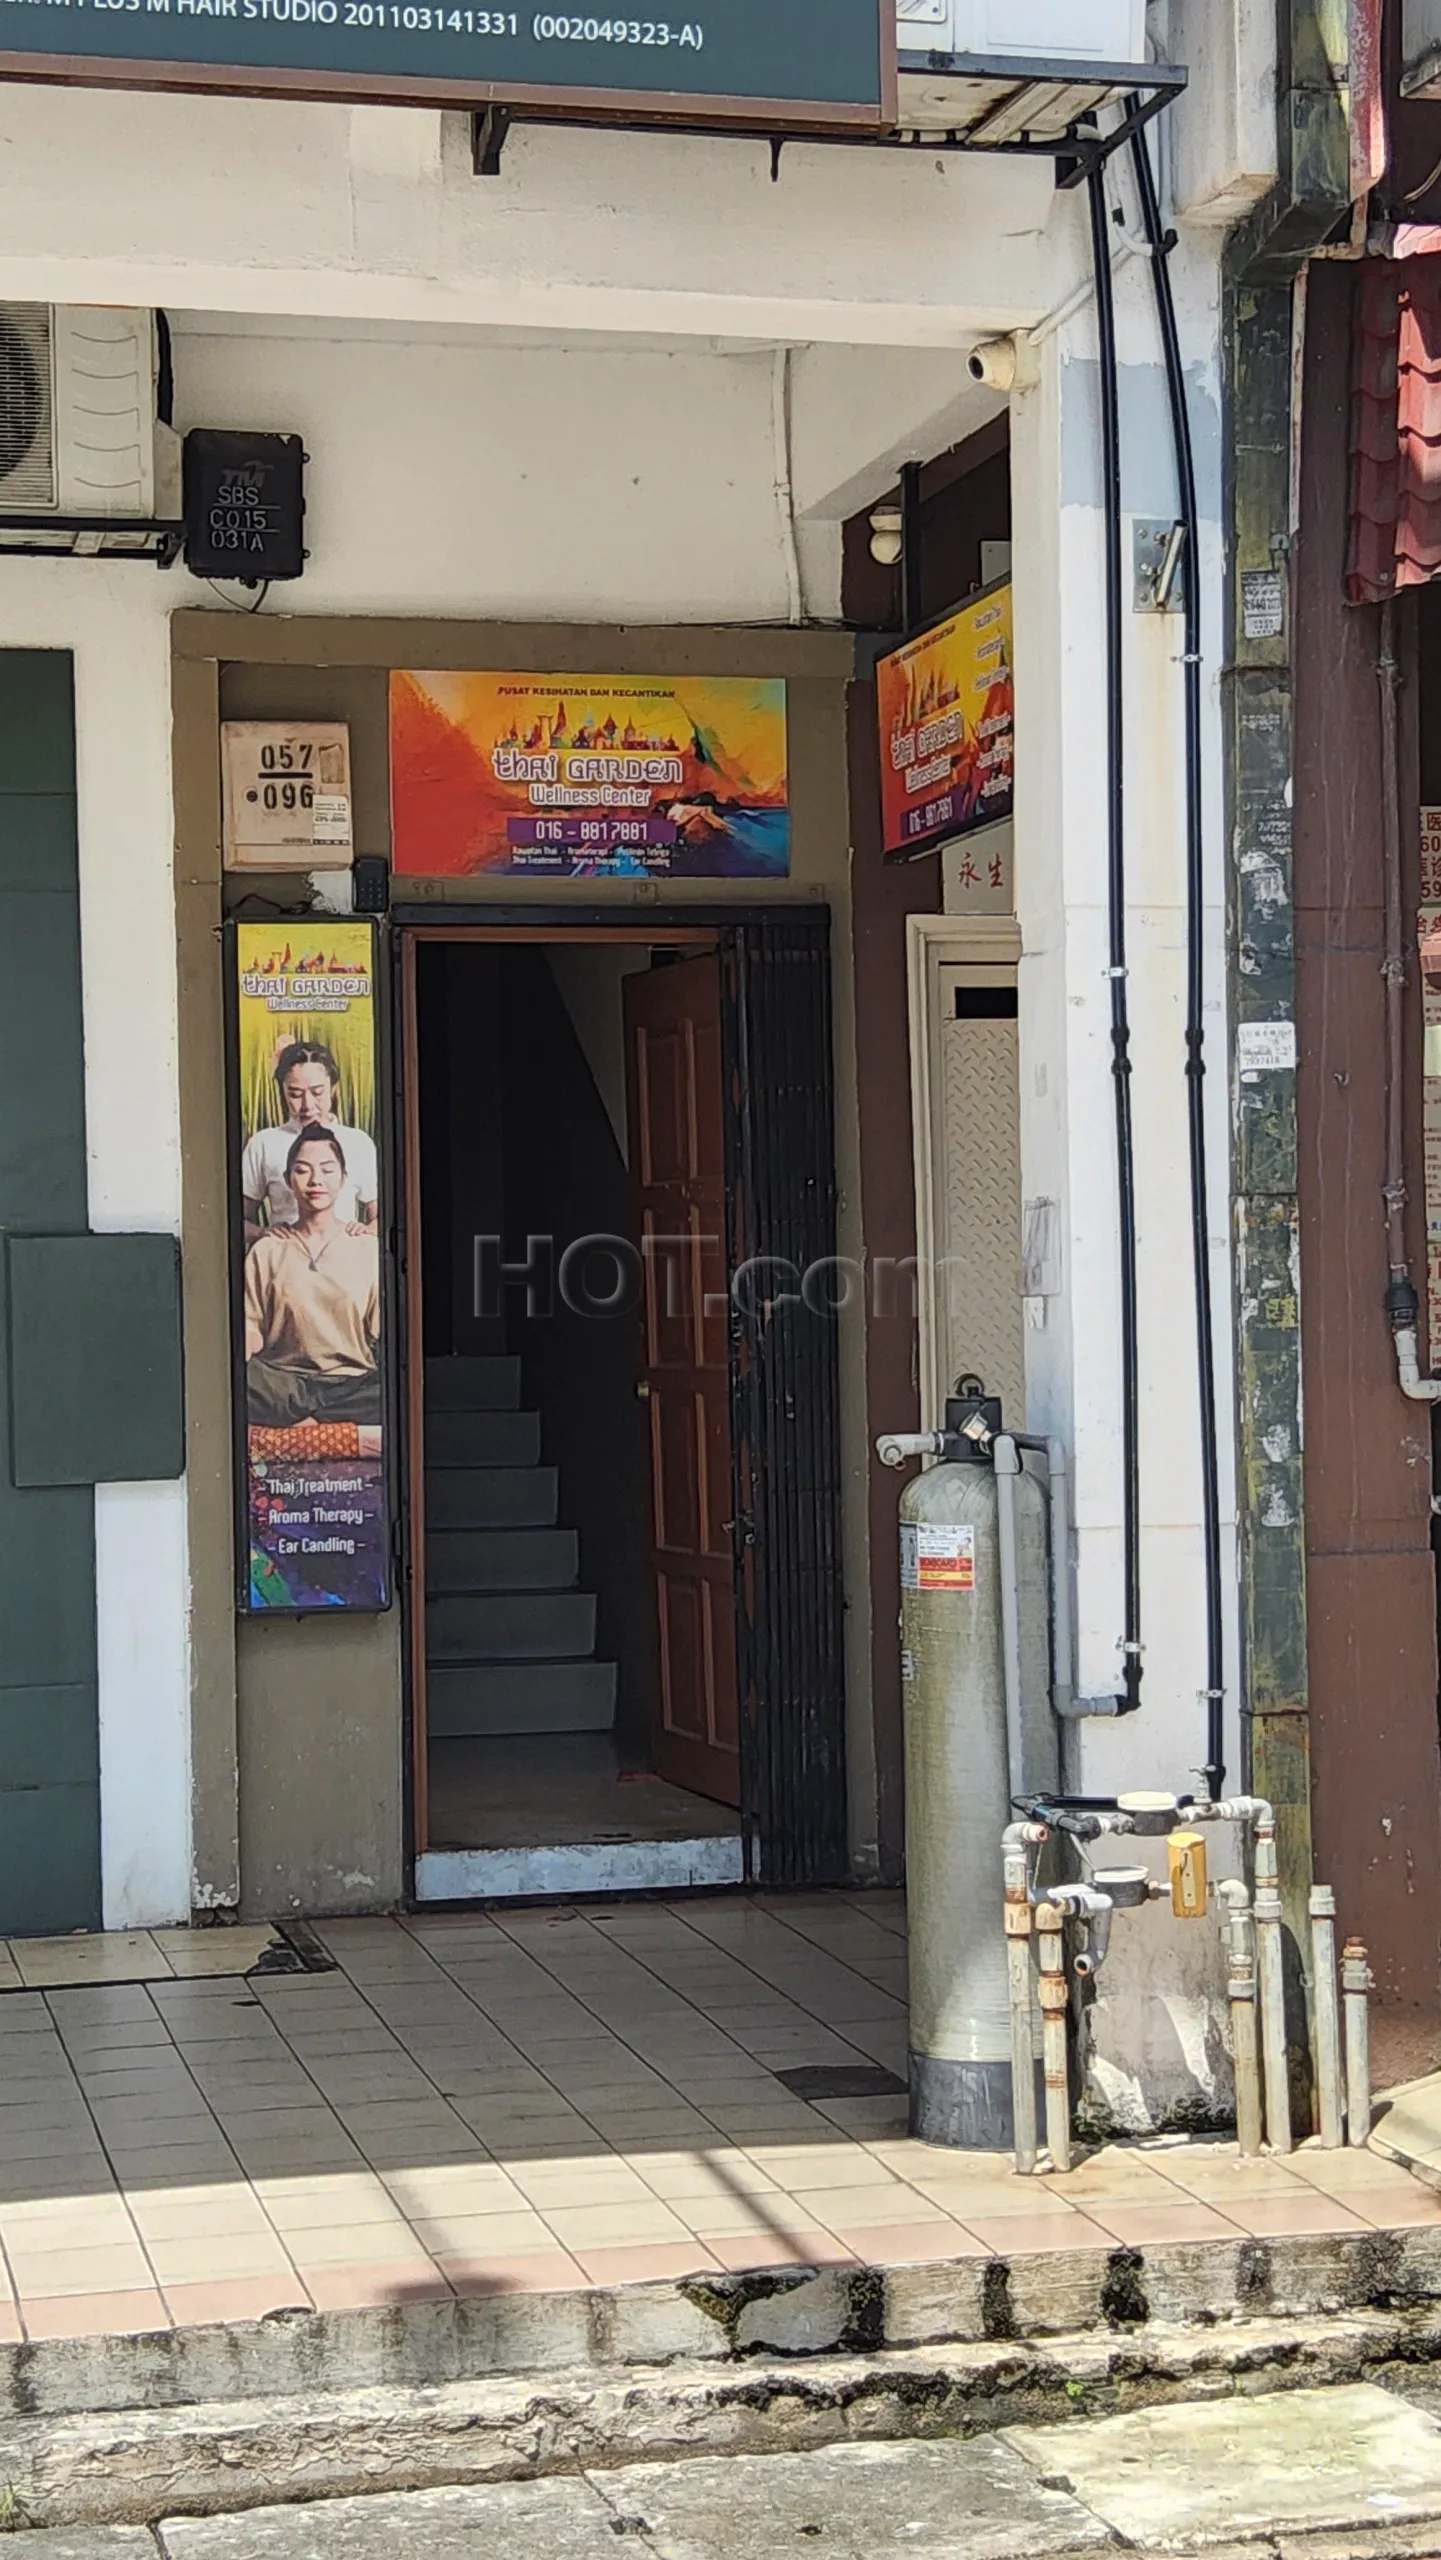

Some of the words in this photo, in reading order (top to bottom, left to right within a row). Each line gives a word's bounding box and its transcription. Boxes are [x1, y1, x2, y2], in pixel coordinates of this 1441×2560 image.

[178, 0, 237, 17] HAIR
[243, 0, 337, 24] STUDIO
[344, 3, 518, 36] 201103141331
[533, 14, 703, 50] (002049323-A)
[218, 486, 259, 506] SBS
[212, 530, 264, 553] 031A
[497, 686, 530, 696] PUSAT
[532, 687, 588, 697] KESIHATAN
[590, 688, 610, 697] DAN
[612, 689, 676, 698] KECANTIKAN
[261, 744, 313, 769] 057
[263, 783, 314, 809] 096
[530, 786, 599, 804] Wellness
[602, 786, 652, 805] Center
[535, 821, 562, 840] 016
[580, 820, 648, 841] 8817881
[958, 851, 1003, 889] 永生
[267, 998, 313, 1009] Wellness
[314, 998, 348, 1010] Center
[269, 1479, 295, 1495] Thai
[299, 1477, 364, 1497] Treatment
[269, 1509, 310, 1525] Aroma
[312, 1507, 364, 1525] Therapy
[278, 1538, 299, 1554] Ear
[302, 1537, 355, 1555] Candling
